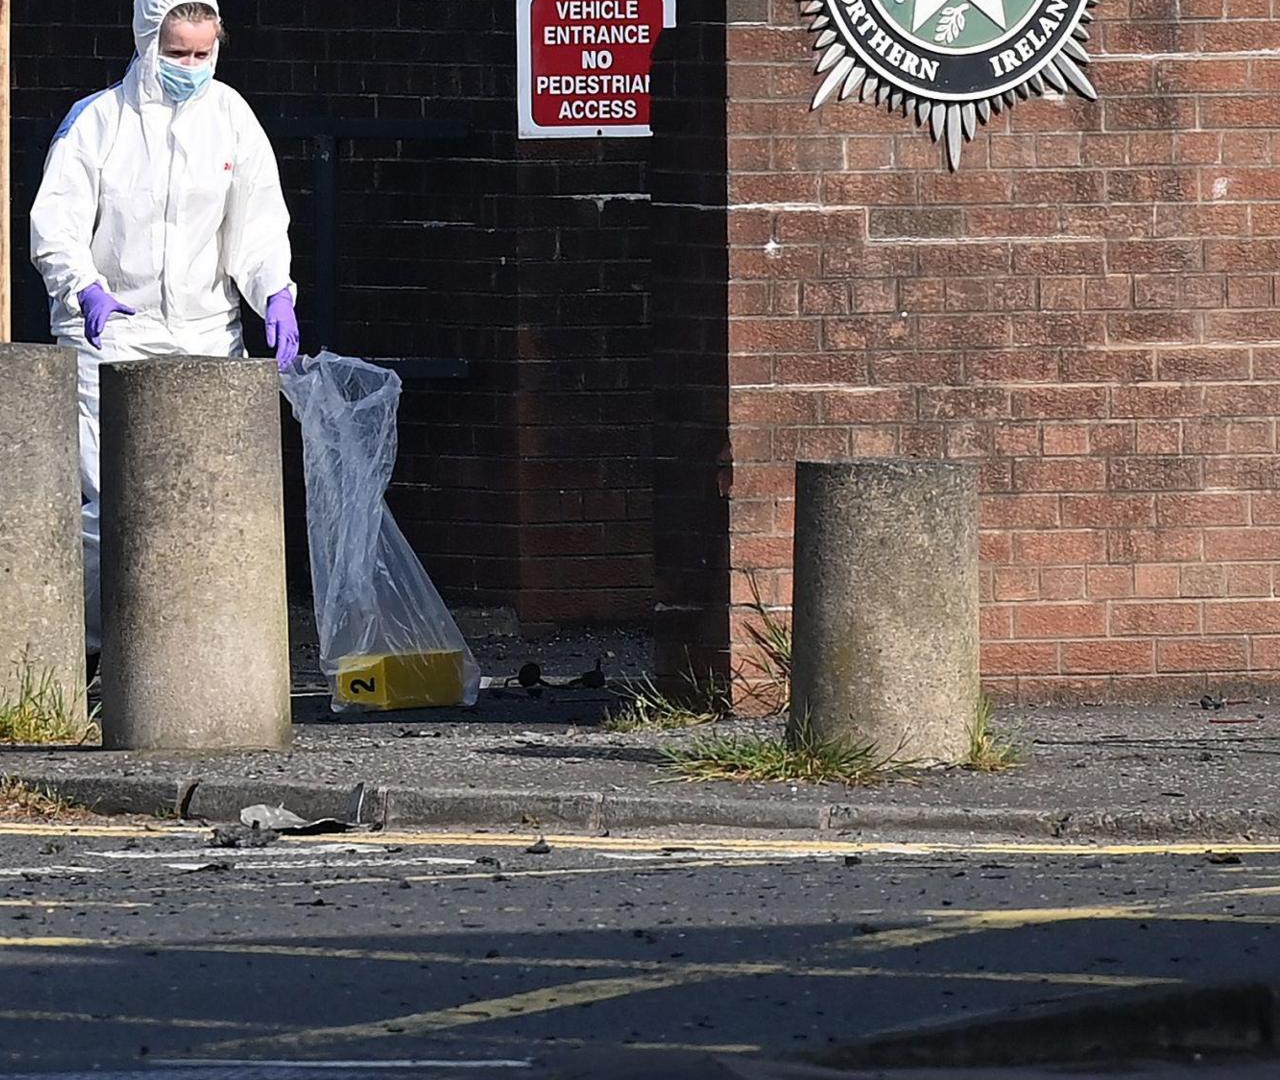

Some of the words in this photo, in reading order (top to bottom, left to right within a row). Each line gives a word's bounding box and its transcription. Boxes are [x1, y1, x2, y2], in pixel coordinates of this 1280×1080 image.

[556, 0, 638, 19] VEHICLE
[544, 25, 650, 45] ENTRANCE
[582, 50, 612, 69] NO
[558, 100, 637, 119] ACCESS
[350, 677, 375, 694] 2
